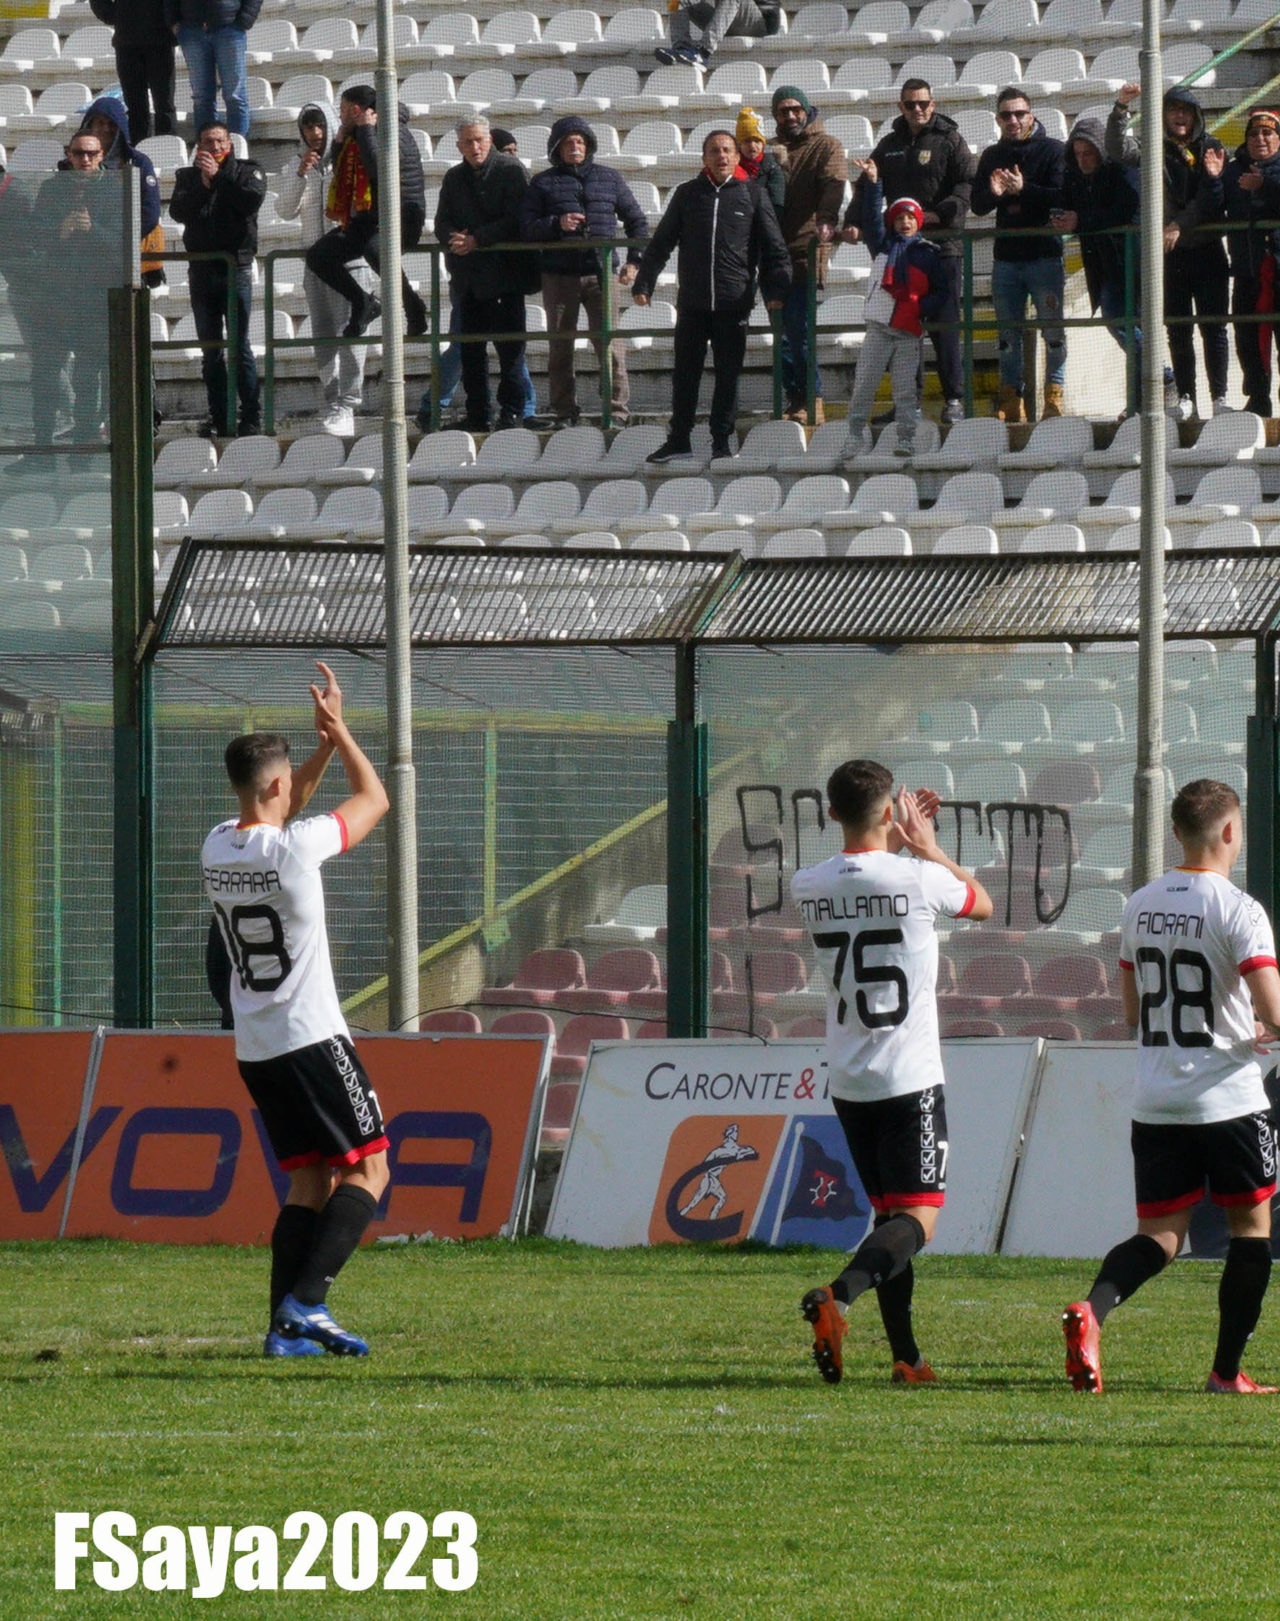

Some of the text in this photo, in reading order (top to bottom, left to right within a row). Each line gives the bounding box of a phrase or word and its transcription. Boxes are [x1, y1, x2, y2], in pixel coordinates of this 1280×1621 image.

[204, 867, 283, 894] FERRARA
[801, 893, 909, 921] MALLAMO
[213, 901, 292, 992] 18
[1136, 911, 1205, 940] FIORANI
[813, 928, 909, 1029] 75
[1136, 946, 1215, 1048] 28
